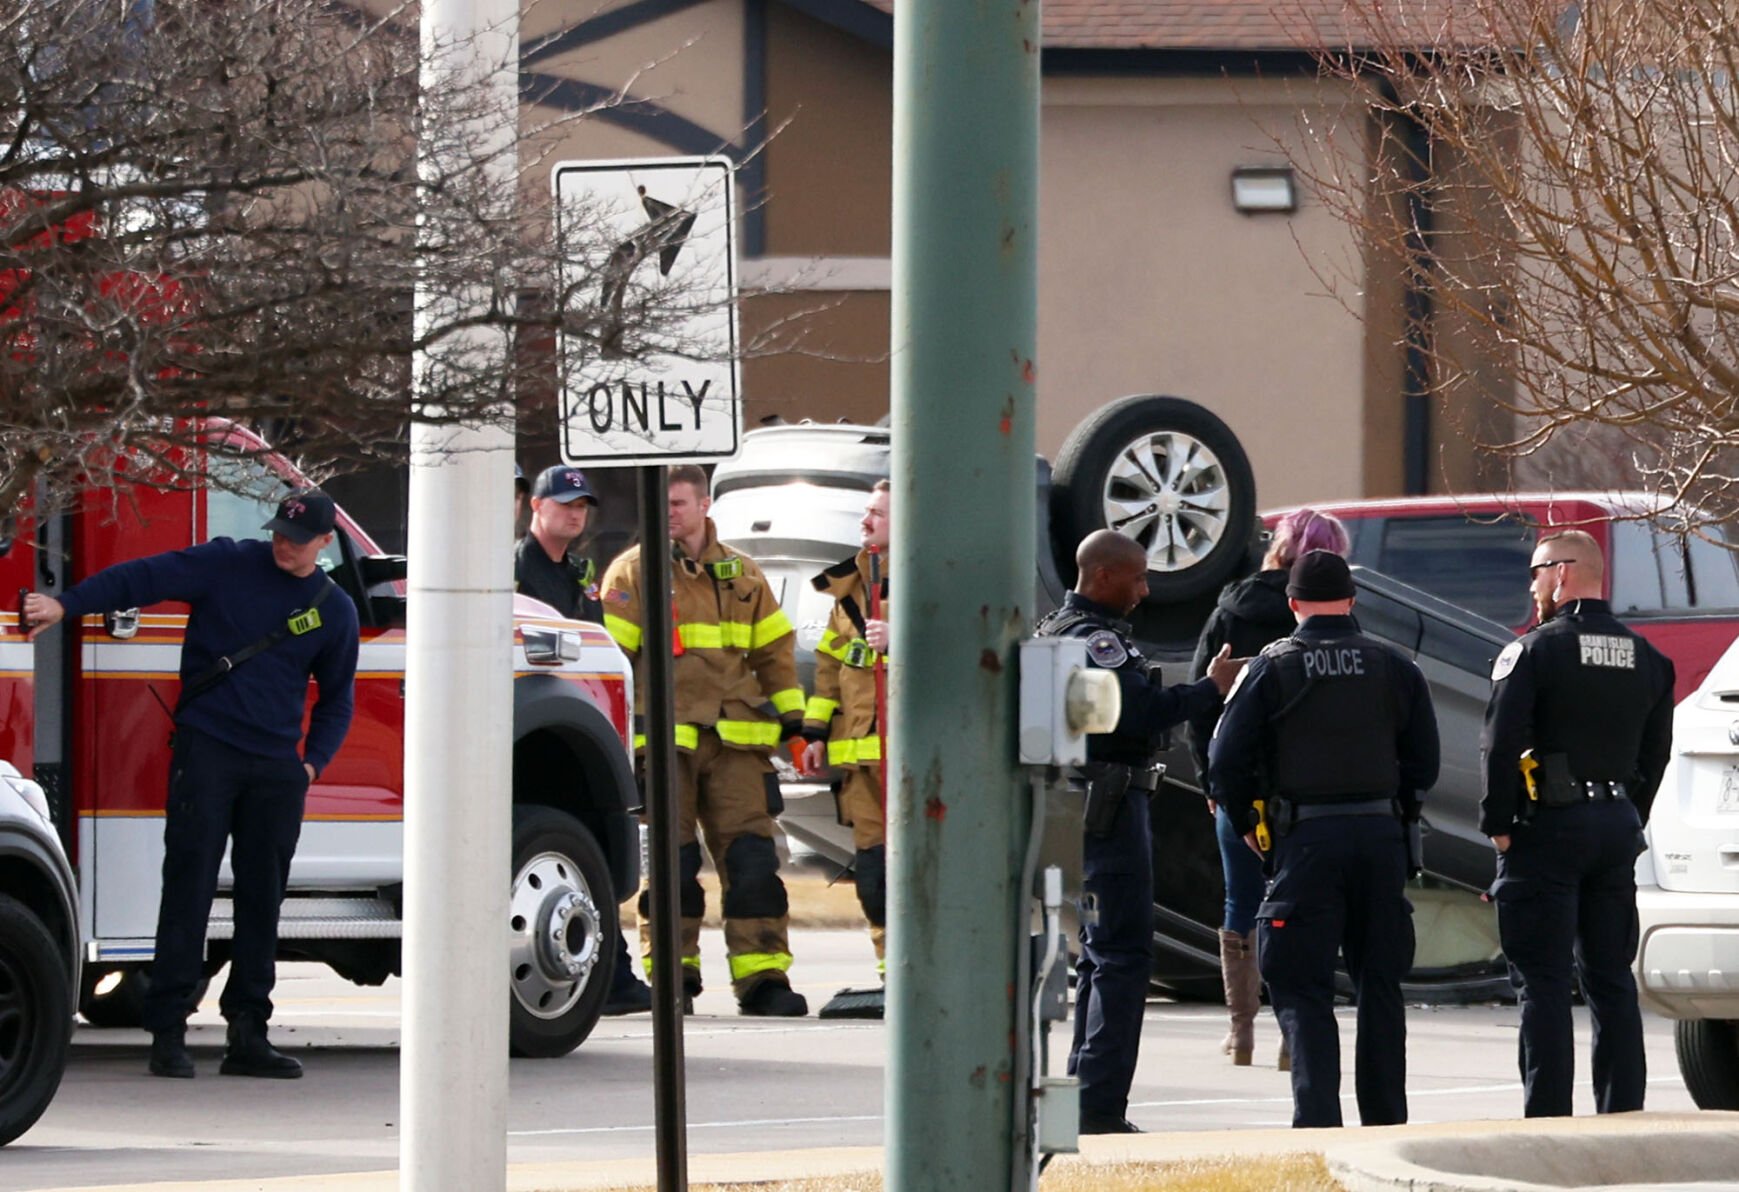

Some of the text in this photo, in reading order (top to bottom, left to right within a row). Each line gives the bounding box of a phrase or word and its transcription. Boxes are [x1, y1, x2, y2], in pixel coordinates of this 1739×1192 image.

[589, 379, 711, 433] ONLY
[1303, 649, 1364, 678] POLICE
[1581, 647, 1635, 668] POLICE
